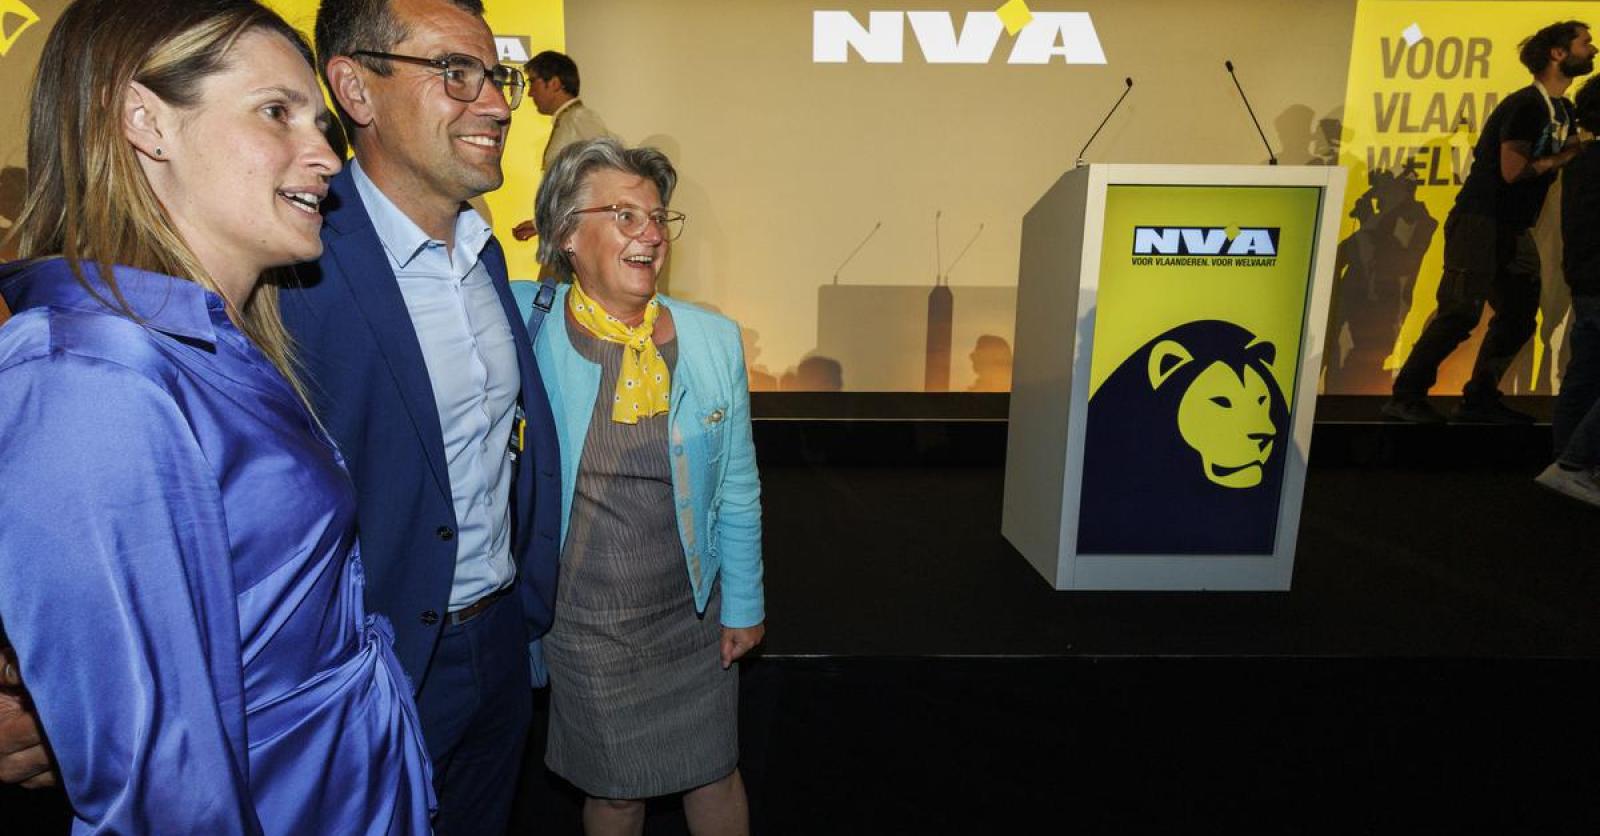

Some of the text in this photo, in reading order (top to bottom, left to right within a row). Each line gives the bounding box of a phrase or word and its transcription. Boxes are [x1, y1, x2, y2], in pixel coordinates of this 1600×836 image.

[1380, 36, 1492, 80] VOOR
[1131, 257, 1153, 266] VOOR
[1211, 258, 1232, 267] VOOR
[1235, 258, 1276, 267] WELVAART
